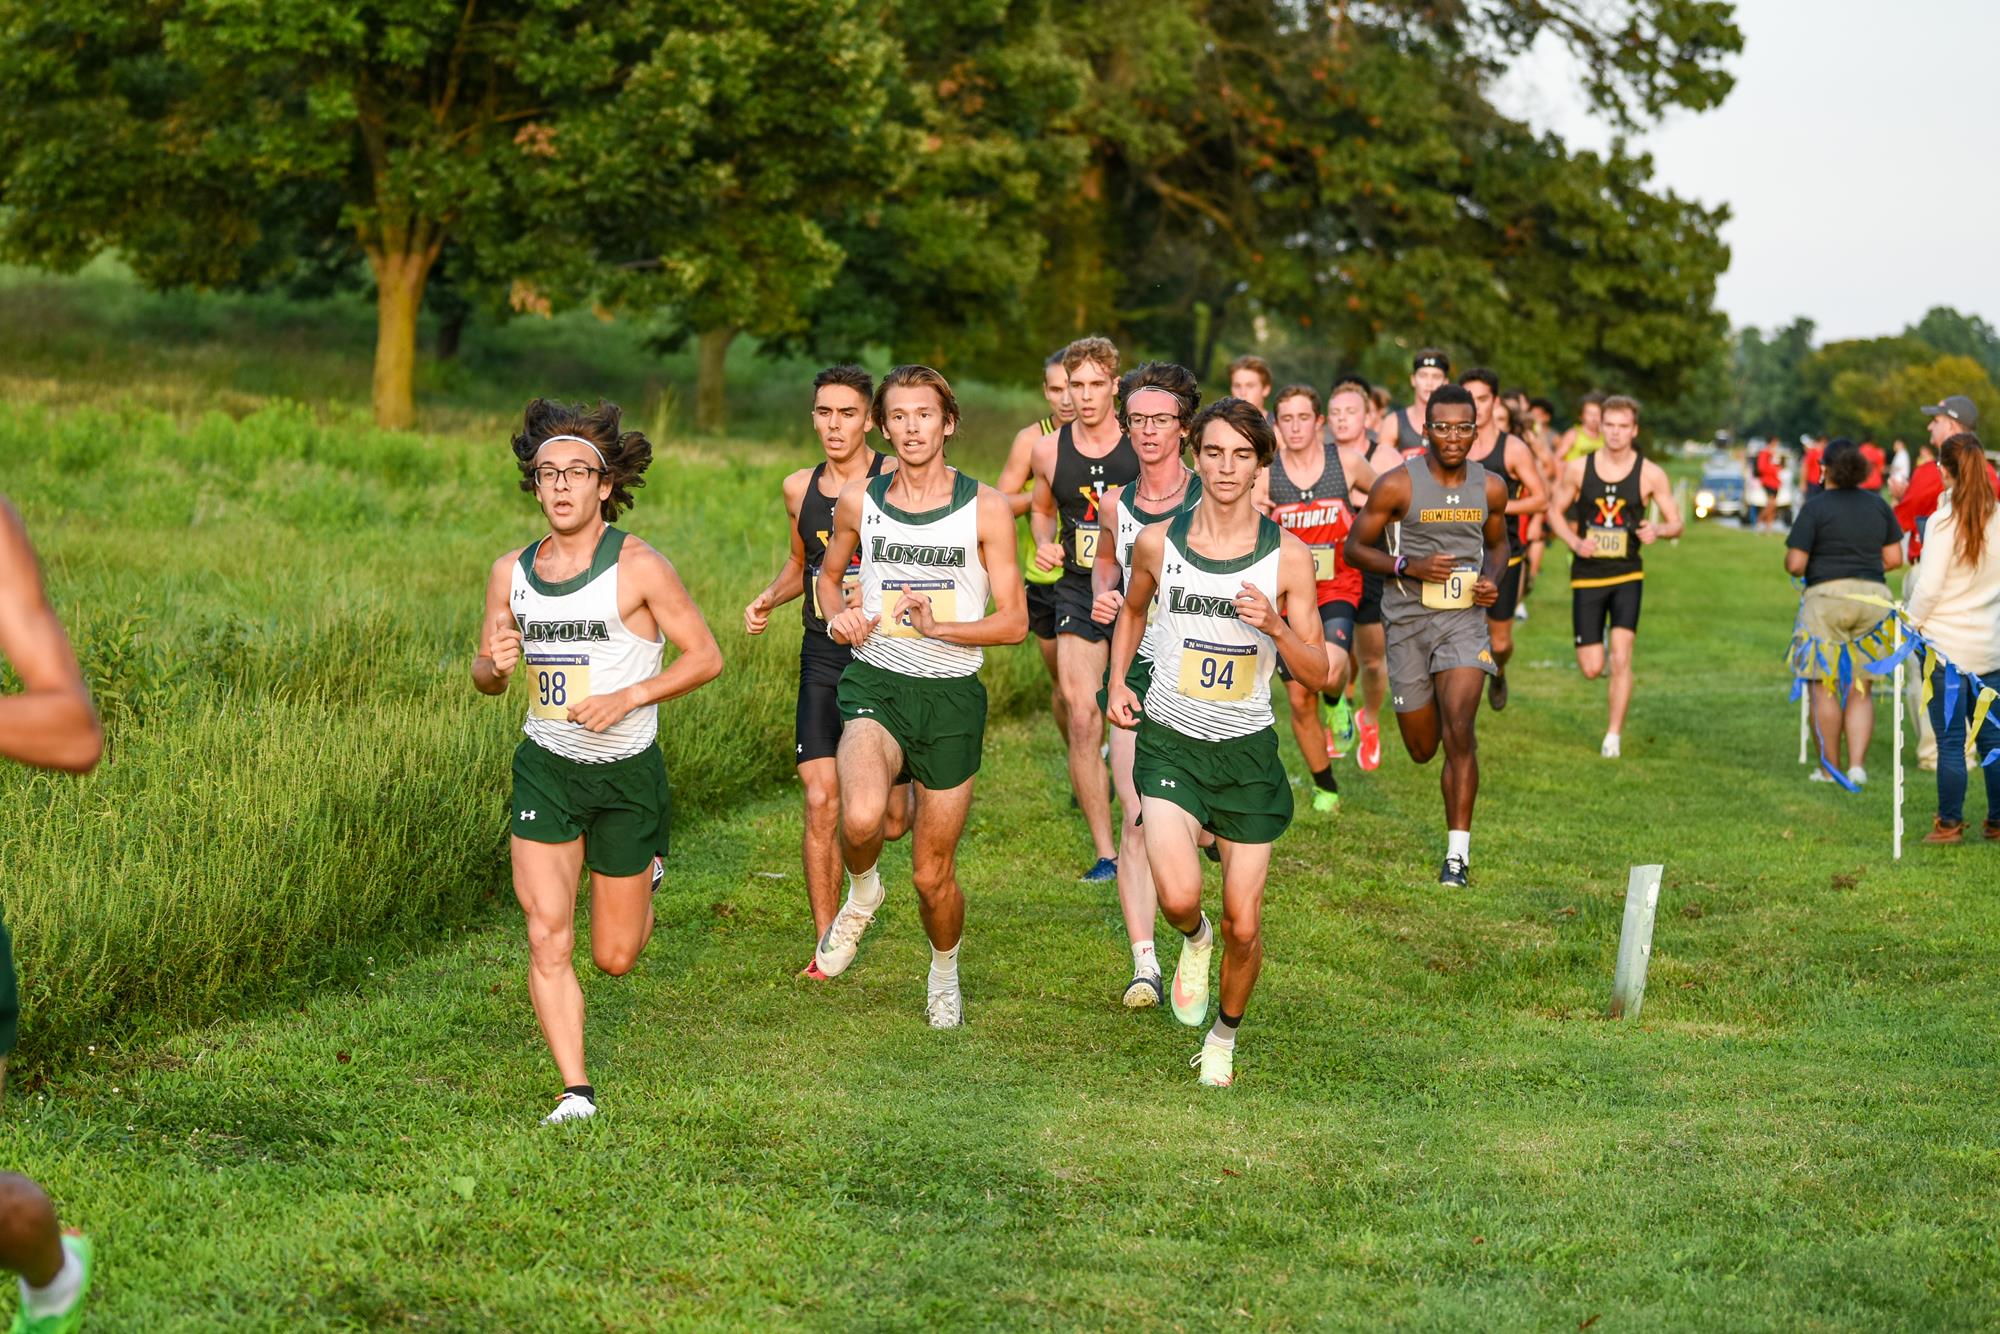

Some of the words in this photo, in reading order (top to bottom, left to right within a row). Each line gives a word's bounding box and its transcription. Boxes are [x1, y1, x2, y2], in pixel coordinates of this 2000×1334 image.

[1281, 506, 1339, 528] CATHOLIC
[1421, 509, 1453, 522] BOWIE
[1455, 508, 1482, 522] STATE
[872, 536, 965, 567] LOYOLA
[1169, 586, 1239, 619] LOYO
[516, 613, 610, 643] LOYOLA
[539, 671, 566, 706] 98
[1200, 657, 1234, 690] 94
